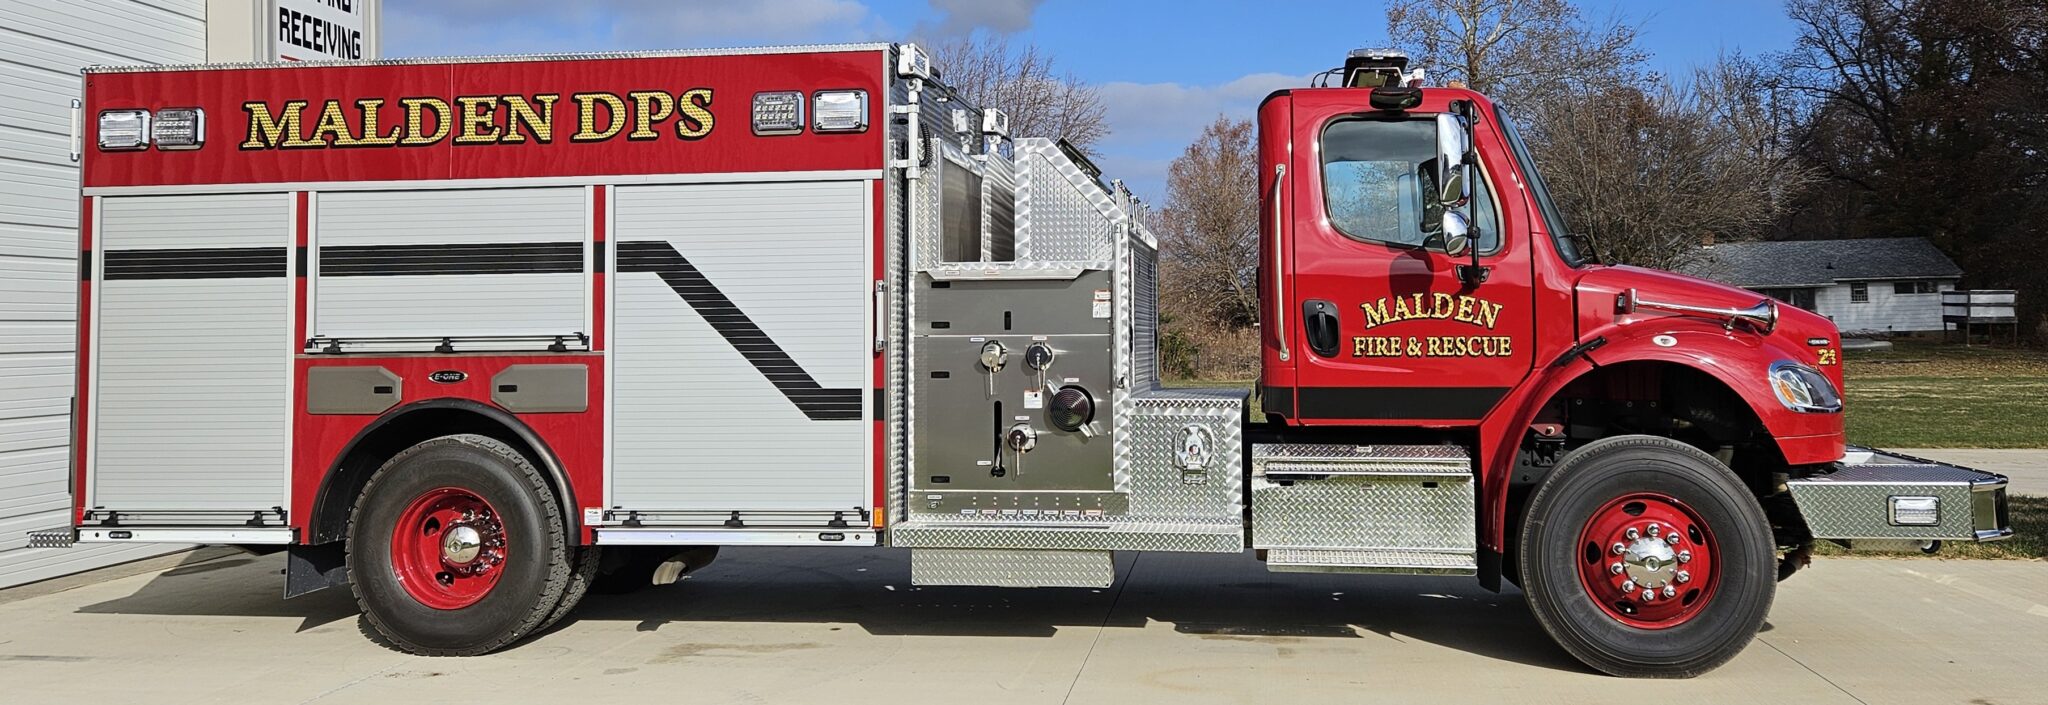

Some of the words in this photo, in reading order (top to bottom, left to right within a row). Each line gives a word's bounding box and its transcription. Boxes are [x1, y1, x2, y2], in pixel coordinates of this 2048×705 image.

[279, 6, 361, 60] RECEIVING
[239, 94, 560, 150] MALDEN
[570, 88, 716, 144] DPS
[1360, 292, 1503, 329] MALDEN
[1353, 336, 1403, 357] FIRE
[1406, 336, 1423, 358] &
[1426, 336, 1513, 357] RESCUE
